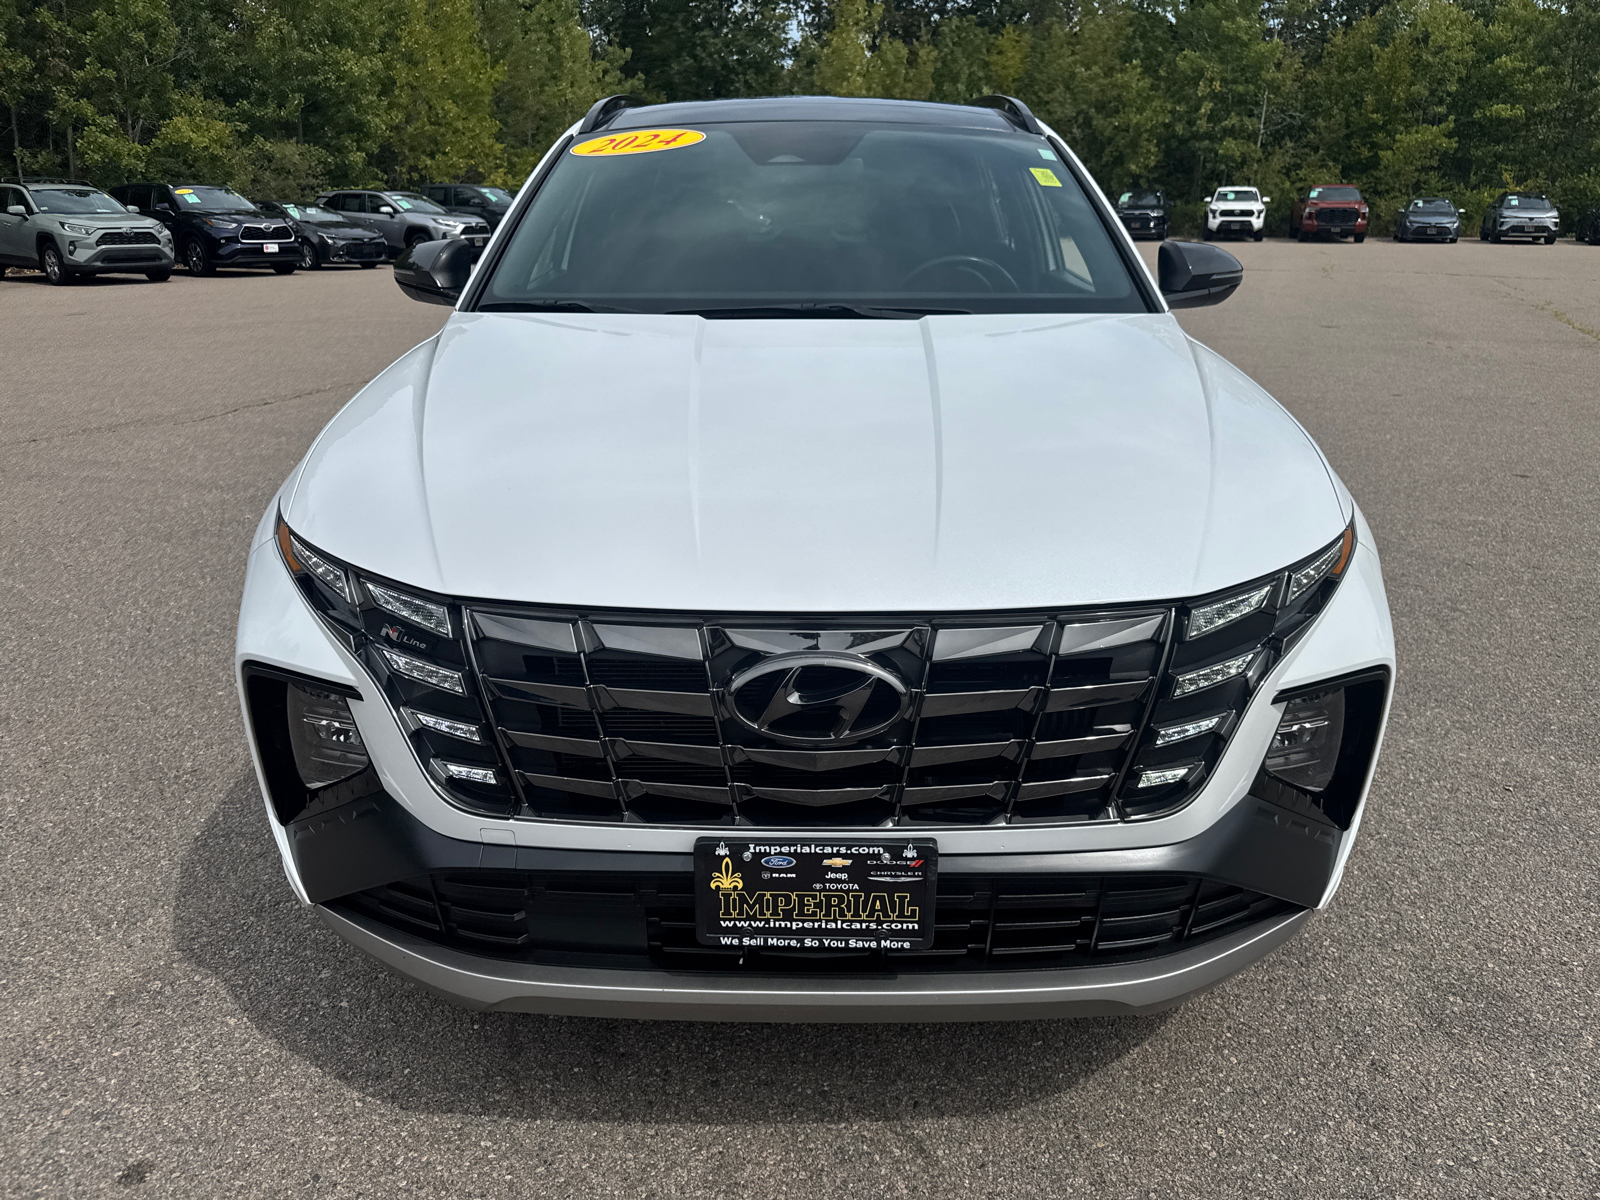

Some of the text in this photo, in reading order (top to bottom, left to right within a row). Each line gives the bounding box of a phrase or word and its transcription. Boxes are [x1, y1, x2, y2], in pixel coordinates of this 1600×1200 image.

[587, 131, 688, 154] 2024
[403, 635, 427, 650] Line
[748, 843, 884, 855] Imperialcars.com
[825, 871, 848, 881] Jeep
[719, 891, 919, 921] IMPERIAL
[720, 919, 919, 930] www.imperialcars.com
[720, 936, 911, 949] We Sell More, So You Save More
